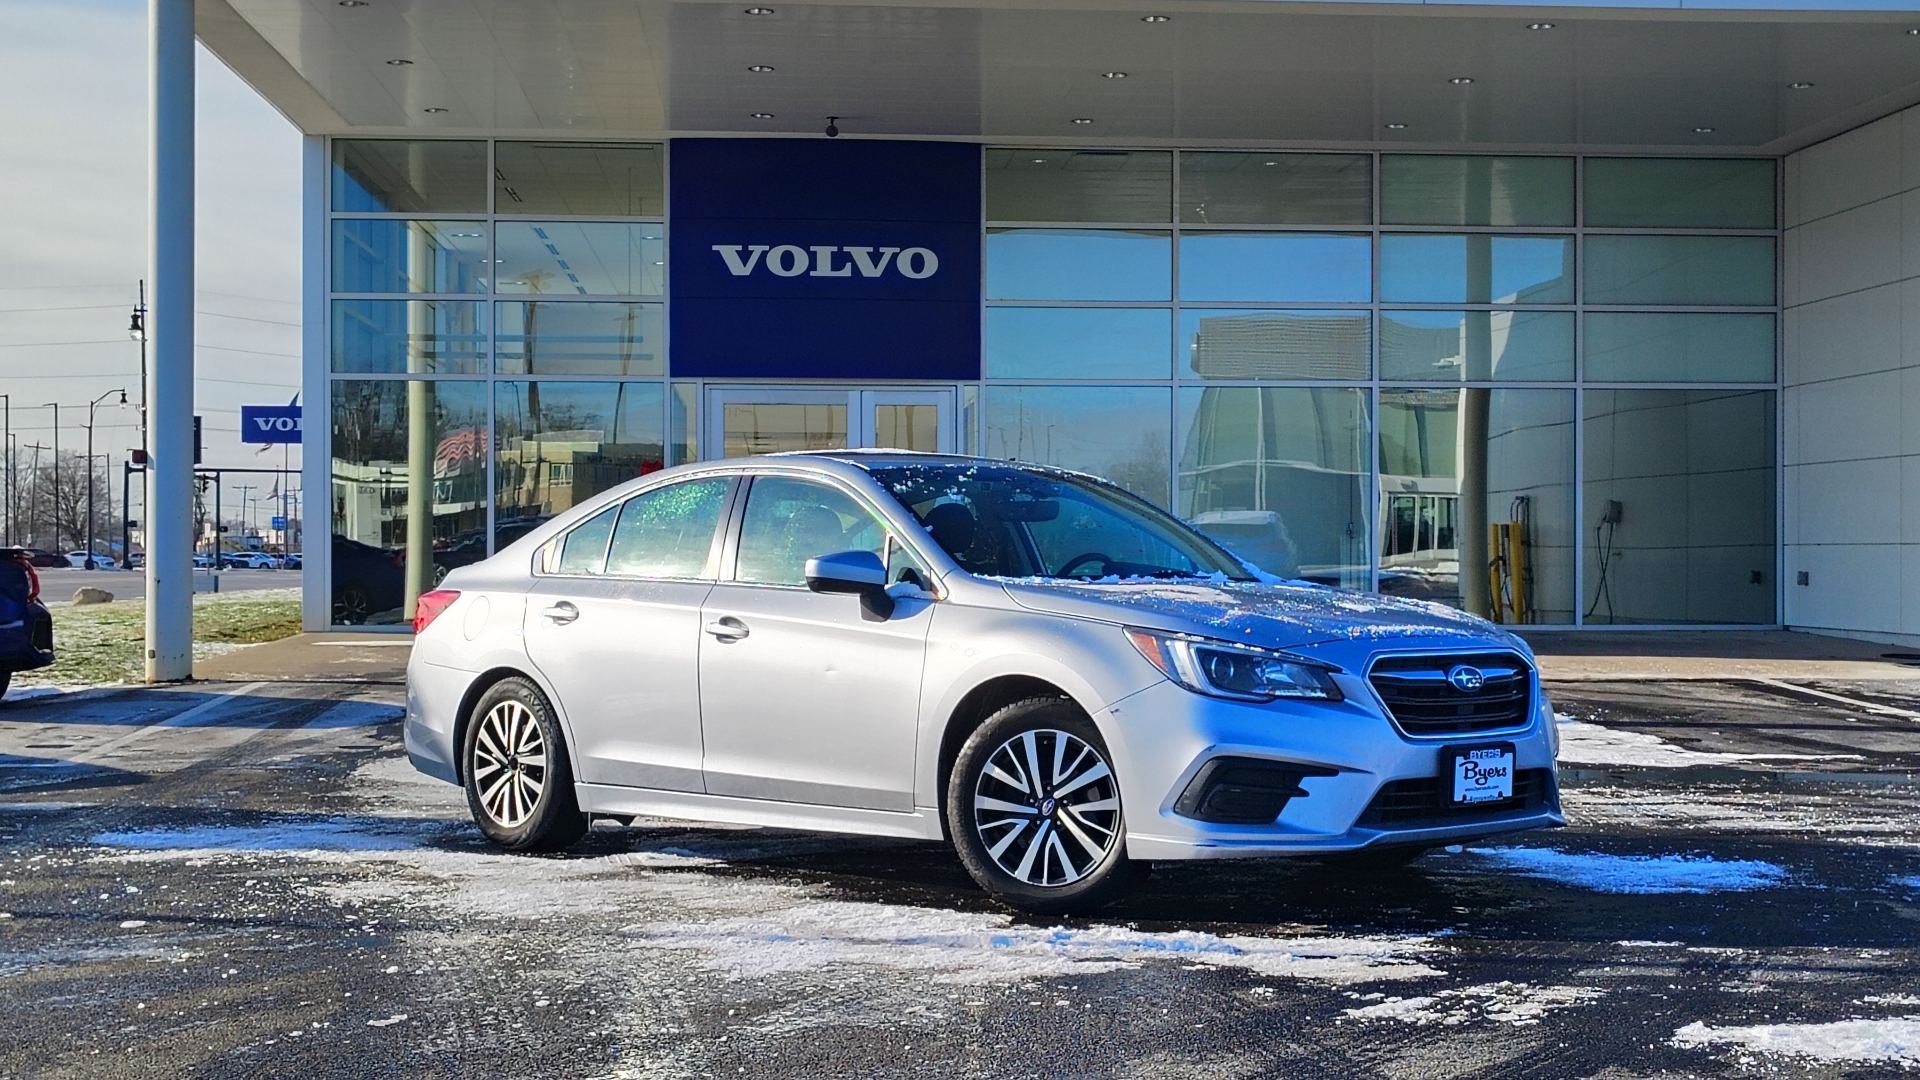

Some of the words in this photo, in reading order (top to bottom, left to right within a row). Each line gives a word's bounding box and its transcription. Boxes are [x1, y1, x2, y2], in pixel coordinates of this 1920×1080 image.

[712, 244, 939, 279] VOLVO
[1470, 749, 1501, 759] BYERS
[1458, 760, 1507, 786] Byers
